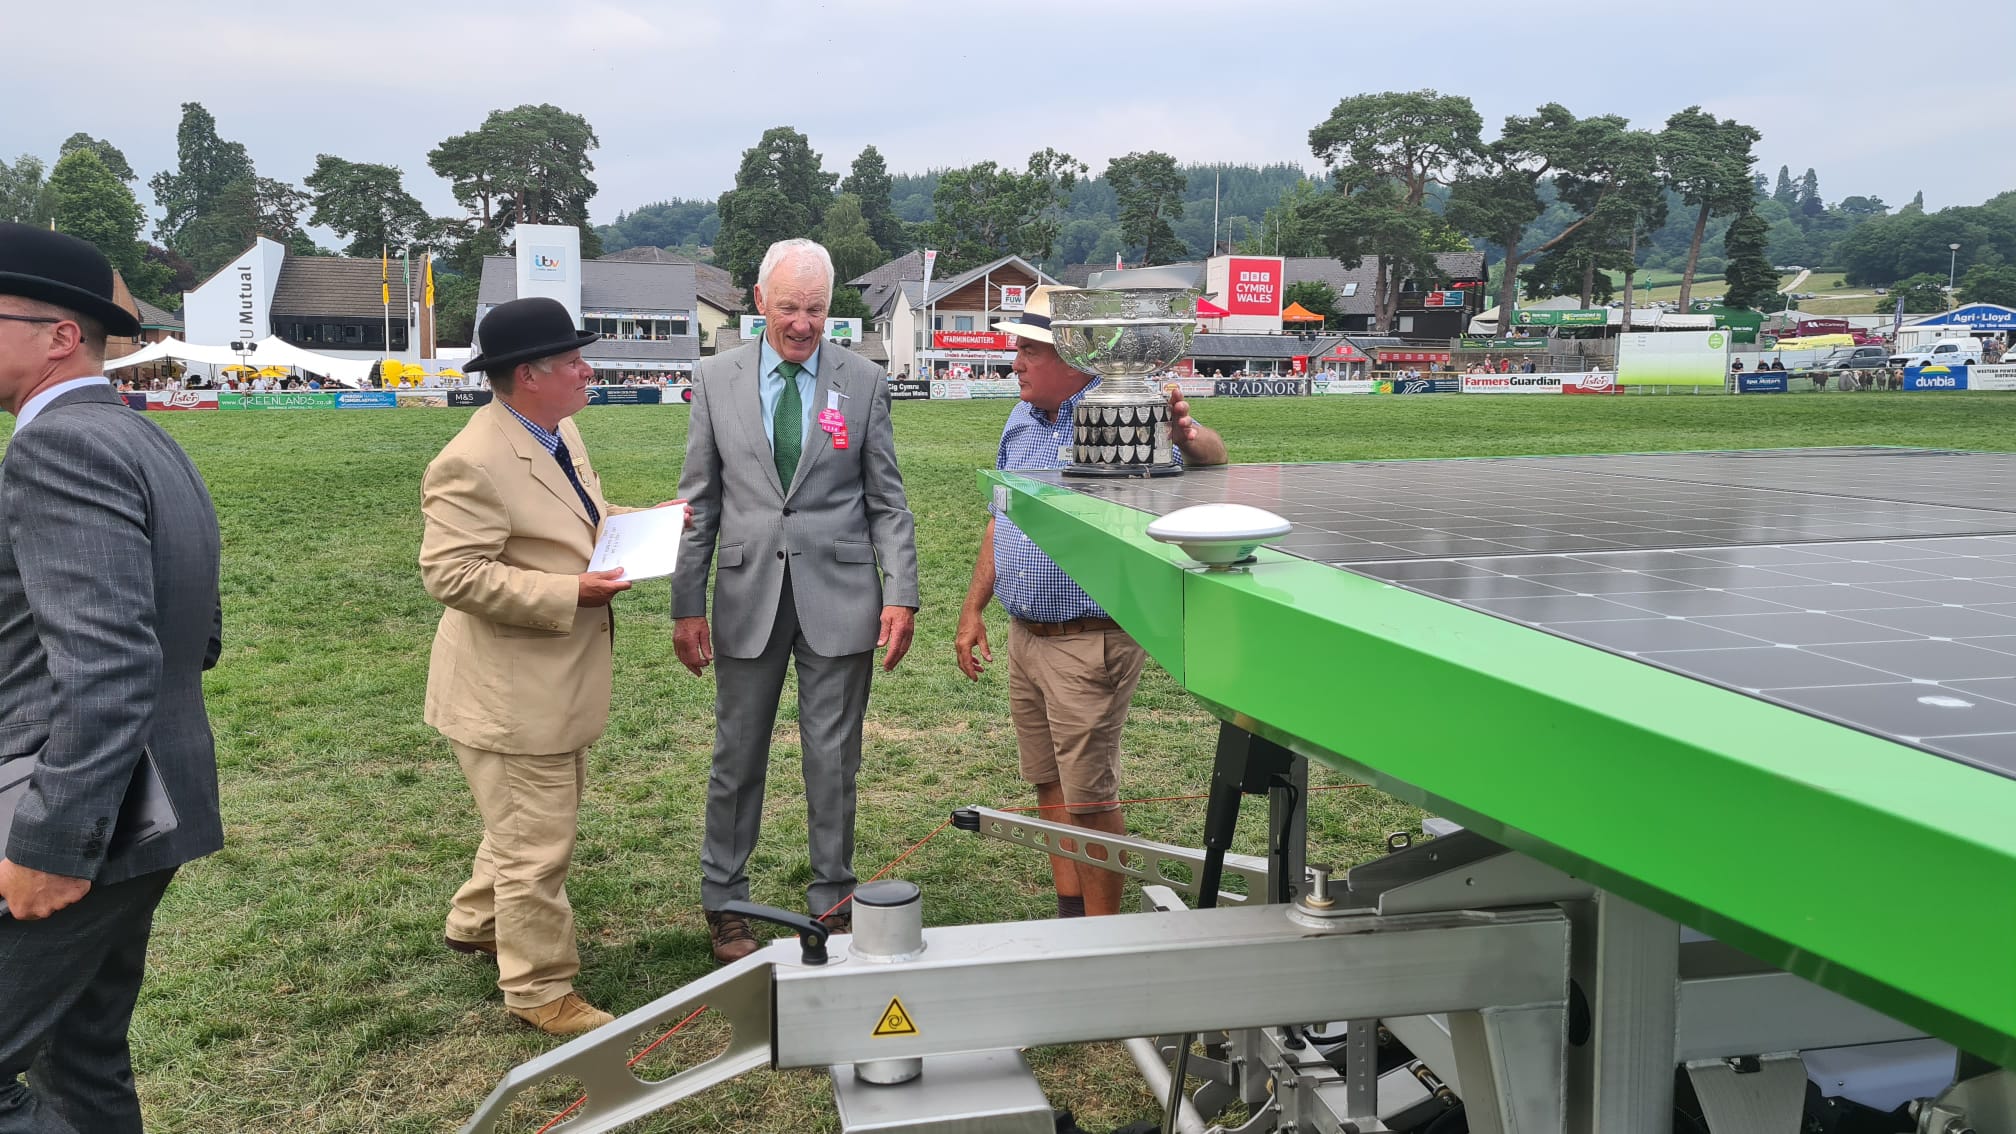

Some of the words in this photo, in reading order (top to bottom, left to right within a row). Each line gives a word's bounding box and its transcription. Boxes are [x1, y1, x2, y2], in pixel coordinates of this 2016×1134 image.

[535, 254, 559, 267] itv
[1240, 271, 1270, 282] BBC
[1236, 283, 1274, 293] CYMRU
[237, 266, 253, 325] Mutual
[1005, 295, 1022, 303] FUW
[1236, 293, 1272, 304] WALES
[1953, 313, 1975, 322] Agri
[1982, 313, 2011, 322] Lloyd
[943, 335, 995, 345] #FARMINGMATTERS
[899, 383, 920, 391] Cymru
[1576, 375, 1609, 391] Lister
[1915, 376, 1955, 387] dunbia
[1229, 381, 1296, 395] RADNOR
[163, 391, 200, 407] Lister
[455, 393, 474, 401] M&S
